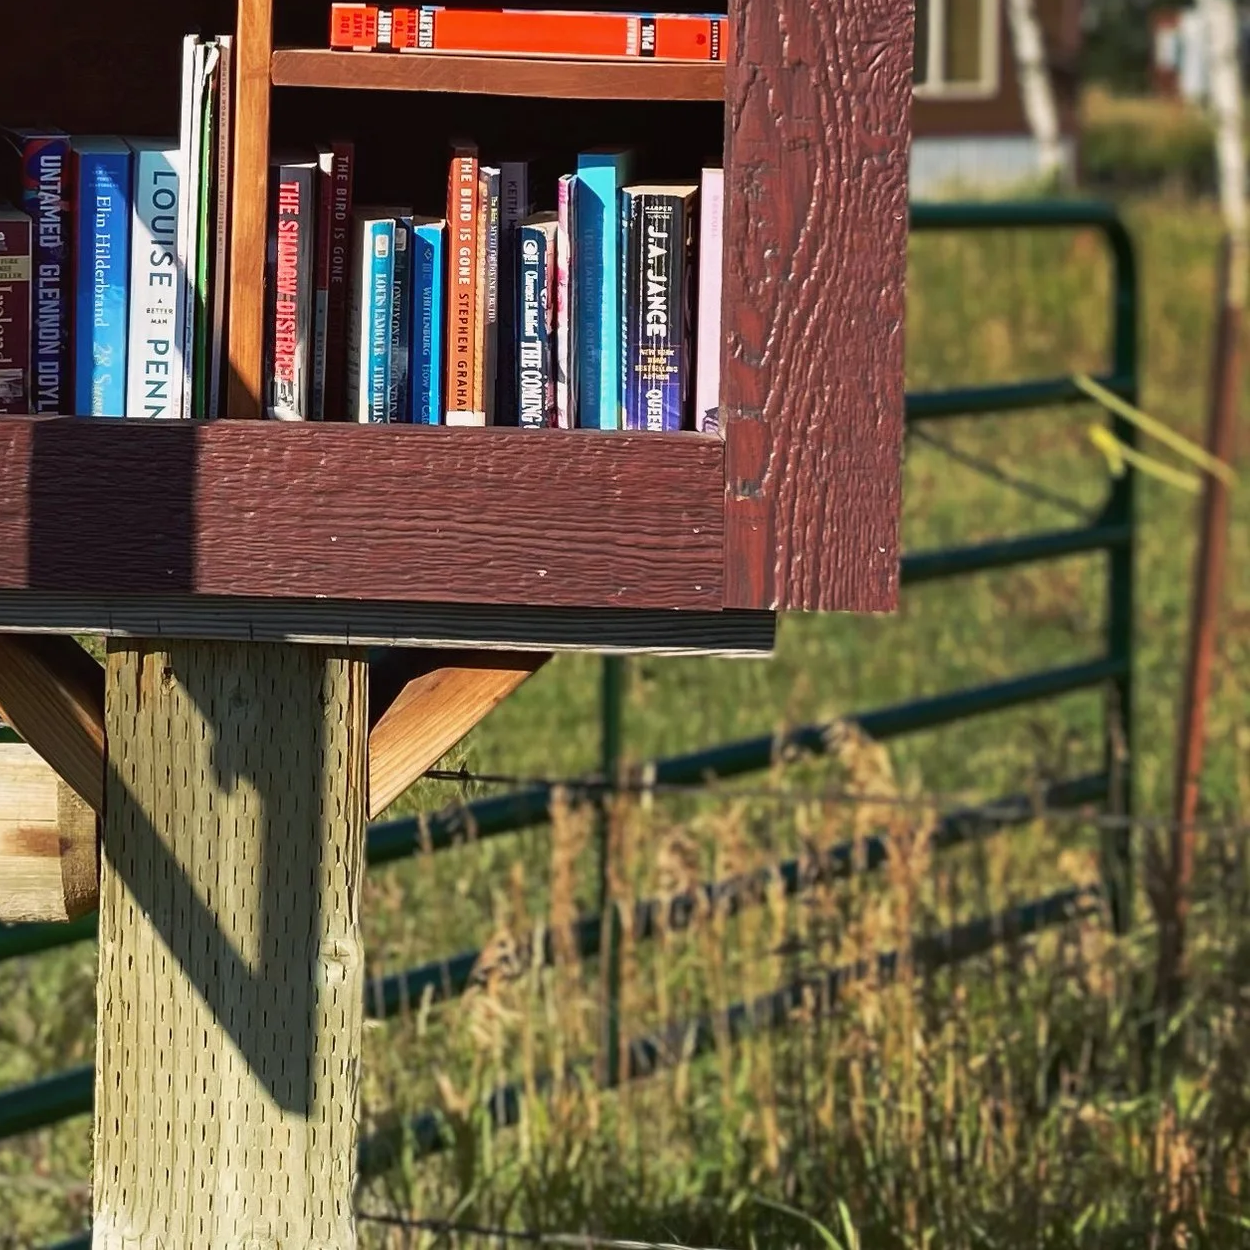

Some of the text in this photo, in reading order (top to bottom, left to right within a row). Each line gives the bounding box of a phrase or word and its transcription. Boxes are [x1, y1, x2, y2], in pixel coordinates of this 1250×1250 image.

[353, 13, 362, 38] HAVE
[366, 15, 375, 38] THE
[377, 10, 392, 44] RIGHT
[395, 20, 404, 33] TO
[406, 9, 416, 48] REMAIN
[418, 10, 434, 48] SILENT
[641, 24, 655, 50] PAUL
[460, 156, 473, 182] THE
[39, 154, 62, 248] UNTAMED
[95, 195, 112, 228] Elin
[279, 181, 300, 215] THE
[459, 188, 472, 221] BIRD
[507, 181, 518, 214] KEITH
[149, 170, 177, 287] LOUISE
[332, 155, 348, 283] THE BIRD IS GONE
[458, 228, 471, 241] IS
[277, 220, 299, 296] SHADOW
[584, 228, 595, 262] LESLIE
[647, 225, 668, 264] J.A.
[93, 233, 111, 327] Hilderbrand
[457, 247, 471, 285] GONE
[374, 273, 387, 306] LOUIS
[584, 264, 595, 312] JAMISON
[646, 269, 667, 337] JANCE
[38, 264, 61, 354] GLENNON
[146, 307, 173, 315] BETTER
[457, 293, 469, 353] STEPHEN
[521, 340, 542, 368] THE
[585, 322, 596, 362] ROBERT
[144, 339, 171, 418] PENN
[372, 364, 385, 424] THE HILLS
[521, 369, 542, 422] COMING
[645, 389, 663, 430] QUEEN
